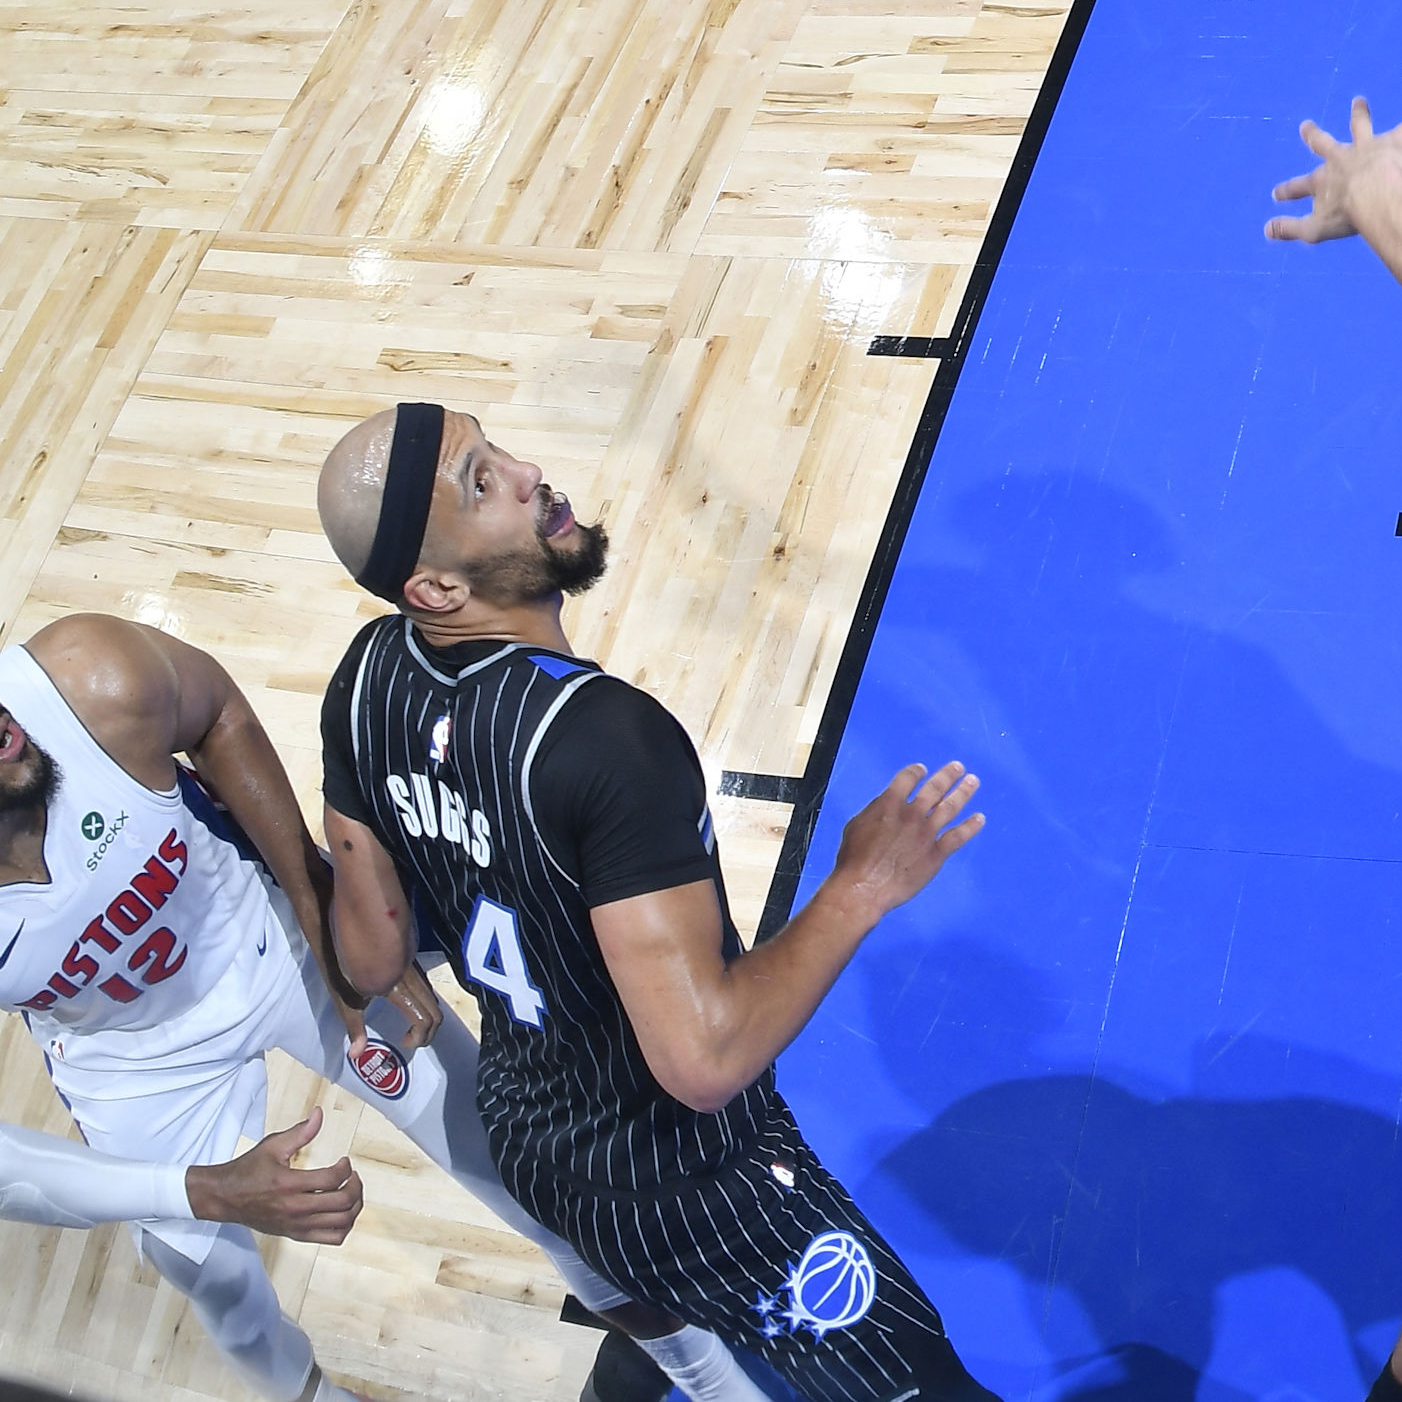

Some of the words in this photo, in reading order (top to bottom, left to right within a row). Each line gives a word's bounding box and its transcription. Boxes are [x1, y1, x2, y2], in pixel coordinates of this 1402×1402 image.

[87, 810, 129, 871] StockX
[13, 827, 188, 1011] PISTONS
[97, 926, 188, 1004] 12
[461, 892, 549, 1032] 4
